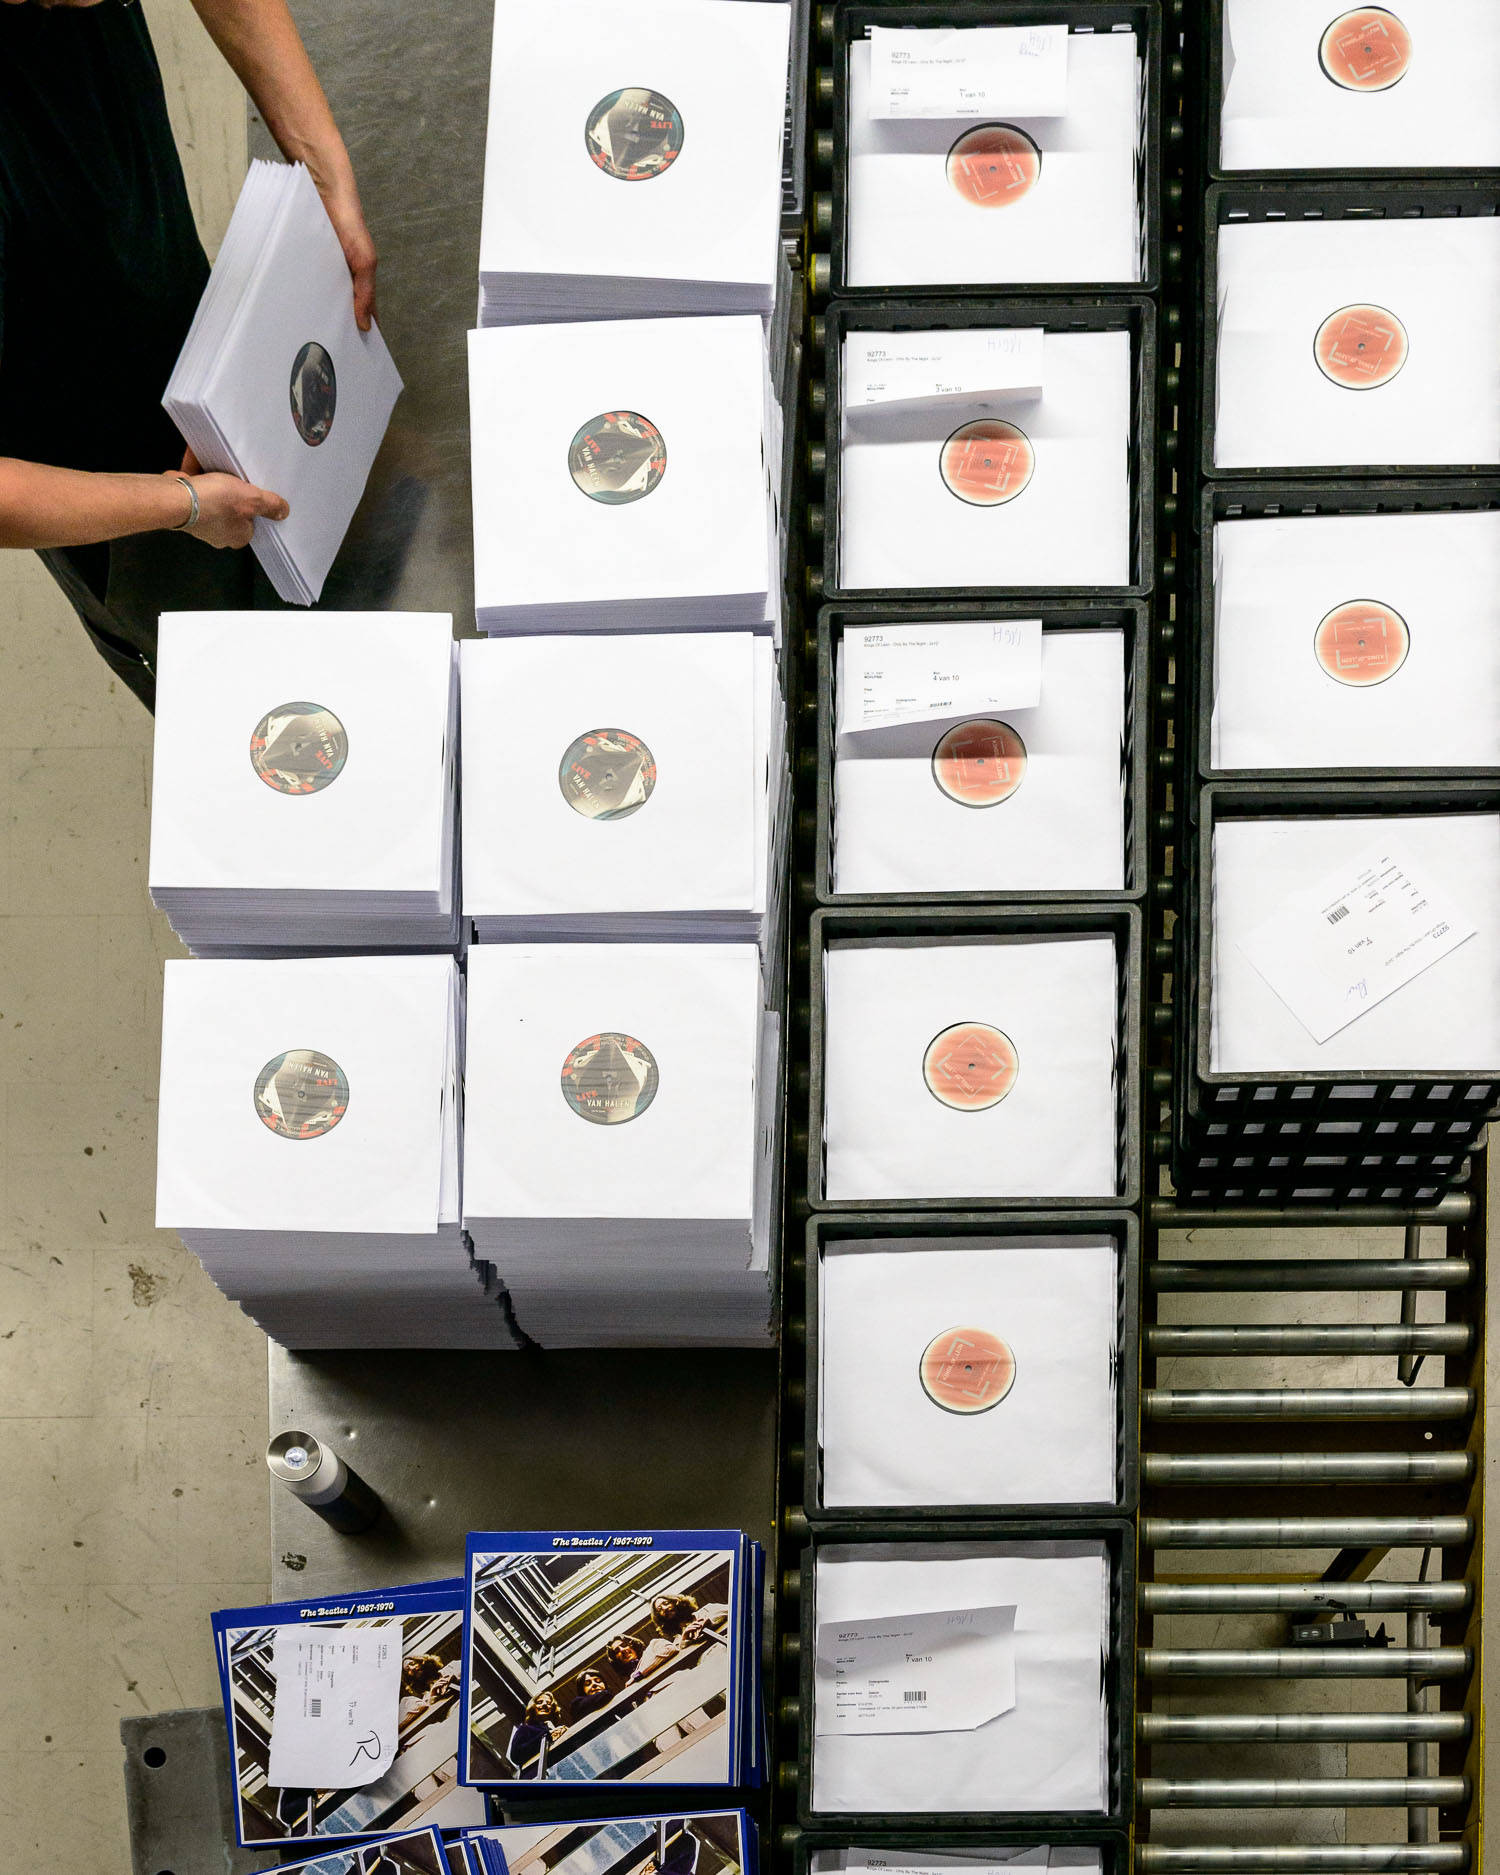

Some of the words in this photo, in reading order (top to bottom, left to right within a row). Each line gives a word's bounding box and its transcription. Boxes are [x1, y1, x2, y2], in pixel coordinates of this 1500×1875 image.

[649, 109, 665, 121] VAN
[582, 446, 593, 461] VAN
[323, 743, 334, 758] VAN
[573, 773, 586, 789] VAN
[314, 1068, 329, 1078] VAN
[587, 1099, 602, 1107] VAN
[604, 1099, 630, 1107] HALEN
[552, 1537, 570, 1546] The
[571, 1537, 604, 1547] Beatles
[612, 1536, 653, 1546] 1967-1970
[301, 1609, 317, 1617] The
[318, 1607, 348, 1616] Beatles
[357, 1602, 394, 1613] 1967-1970
[349, 1730, 381, 1766] R
